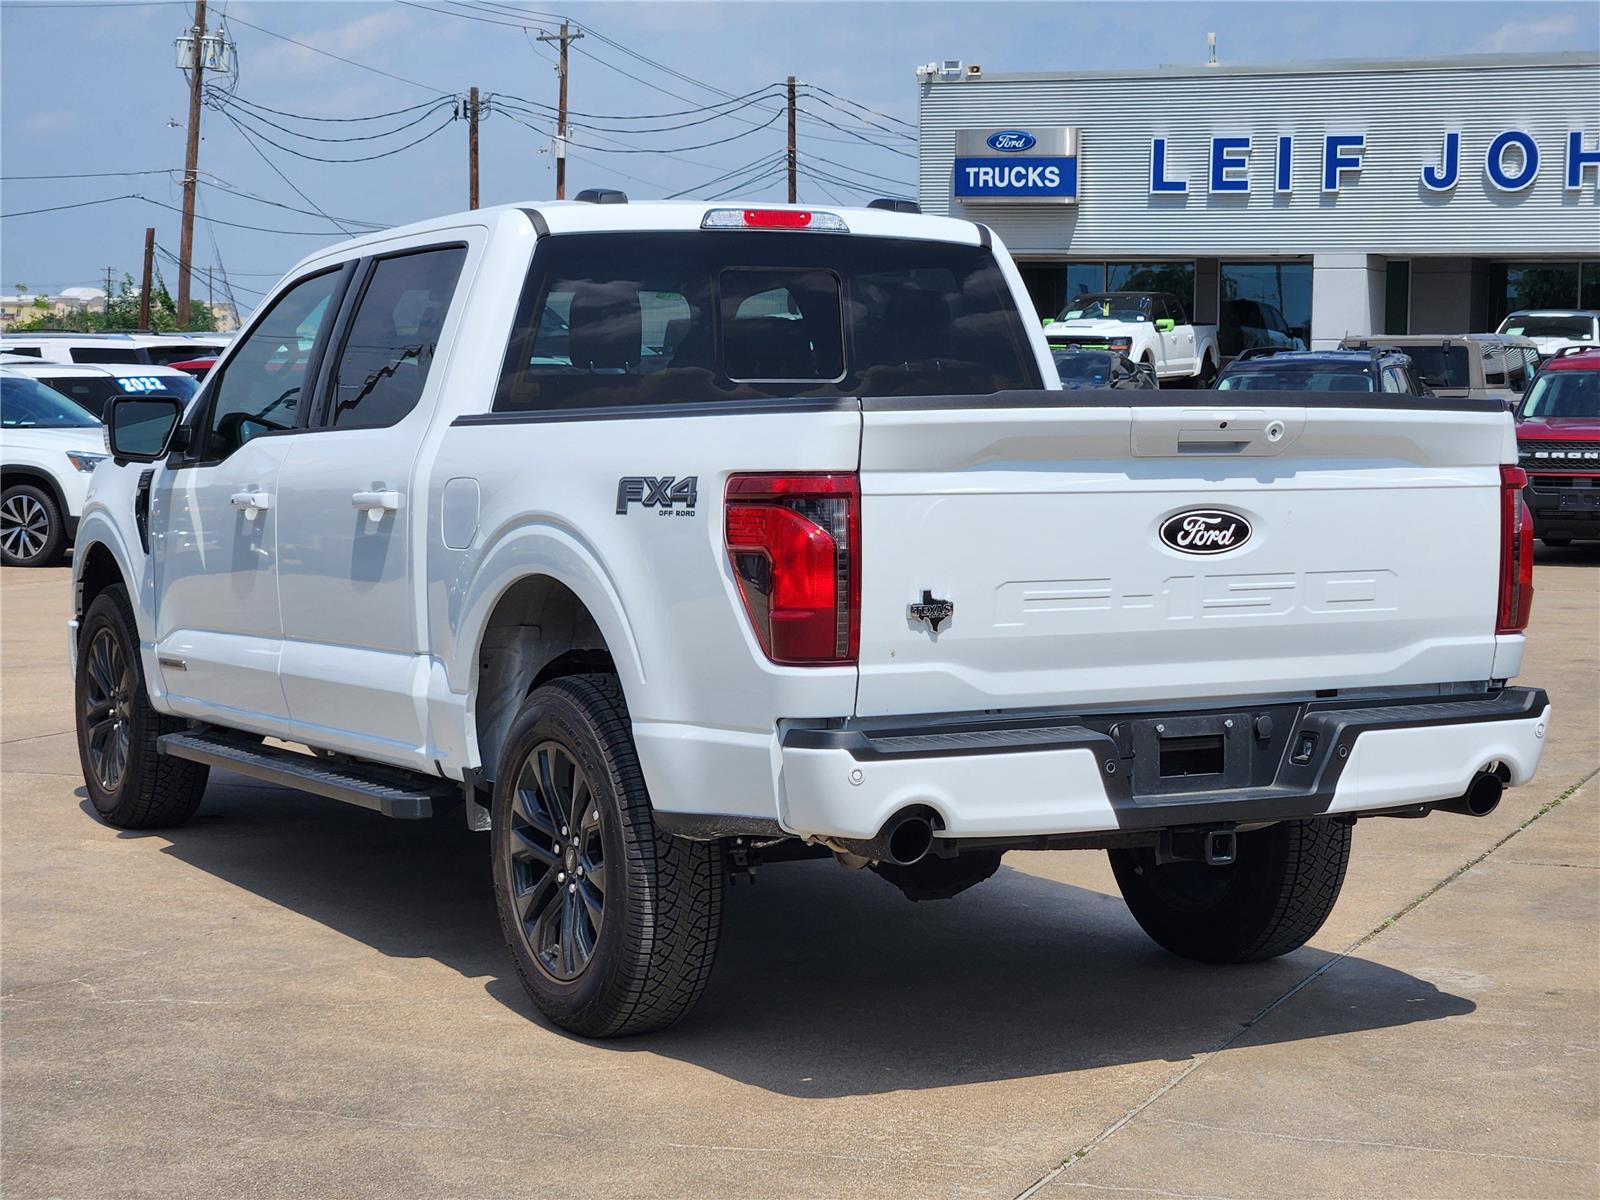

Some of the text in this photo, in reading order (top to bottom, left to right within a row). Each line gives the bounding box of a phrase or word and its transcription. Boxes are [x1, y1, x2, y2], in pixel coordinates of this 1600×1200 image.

[995, 134, 1026, 148] Ford
[1150, 128, 1600, 194] LEIF JOH
[965, 166, 1060, 188] TRUCKS
[118, 377, 168, 392] 2022
[616, 476, 698, 515] FX4
[1177, 516, 1237, 546] Ford
[911, 603, 952, 617] TEXAS
[993, 569, 1399, 627] F-150
